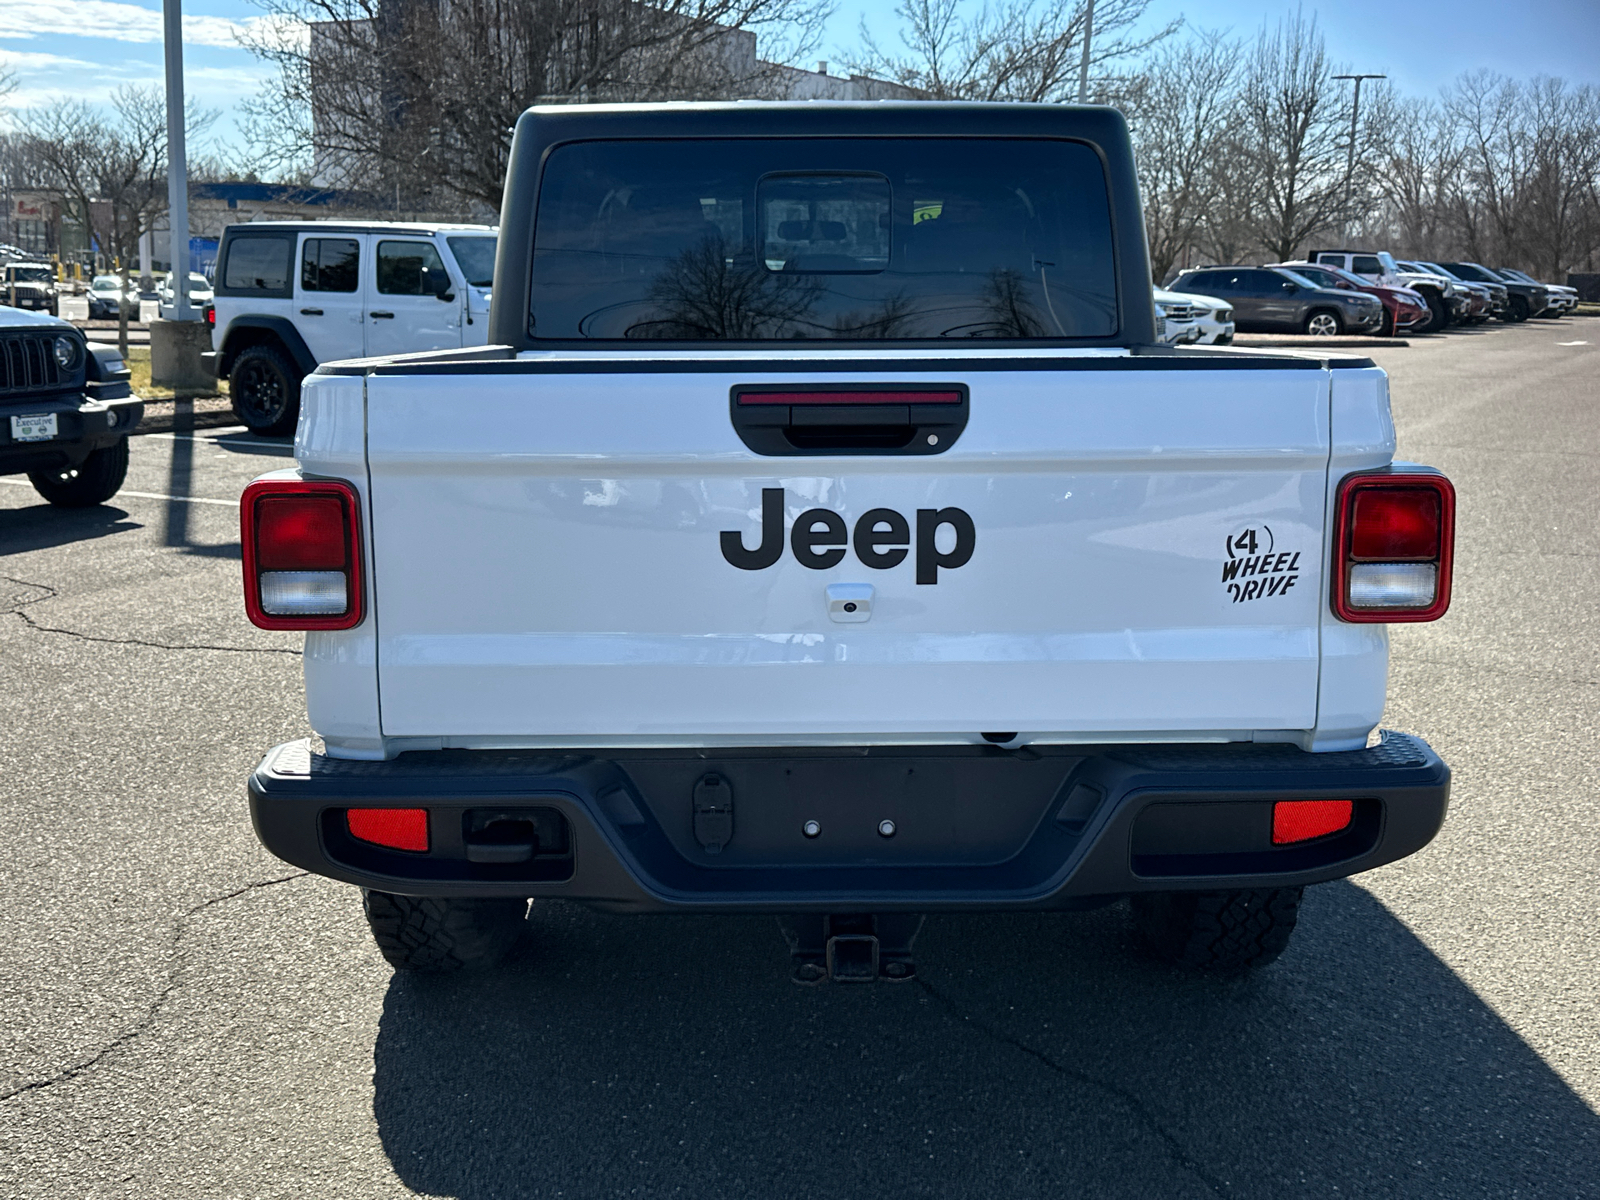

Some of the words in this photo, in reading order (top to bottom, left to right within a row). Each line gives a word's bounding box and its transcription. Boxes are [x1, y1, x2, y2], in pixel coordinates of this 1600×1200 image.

[16, 418, 52, 427] Executive
[720, 488, 975, 584] Jeep
[1222, 552, 1301, 583] WHEEL
[1227, 575, 1298, 603] DRIVE
